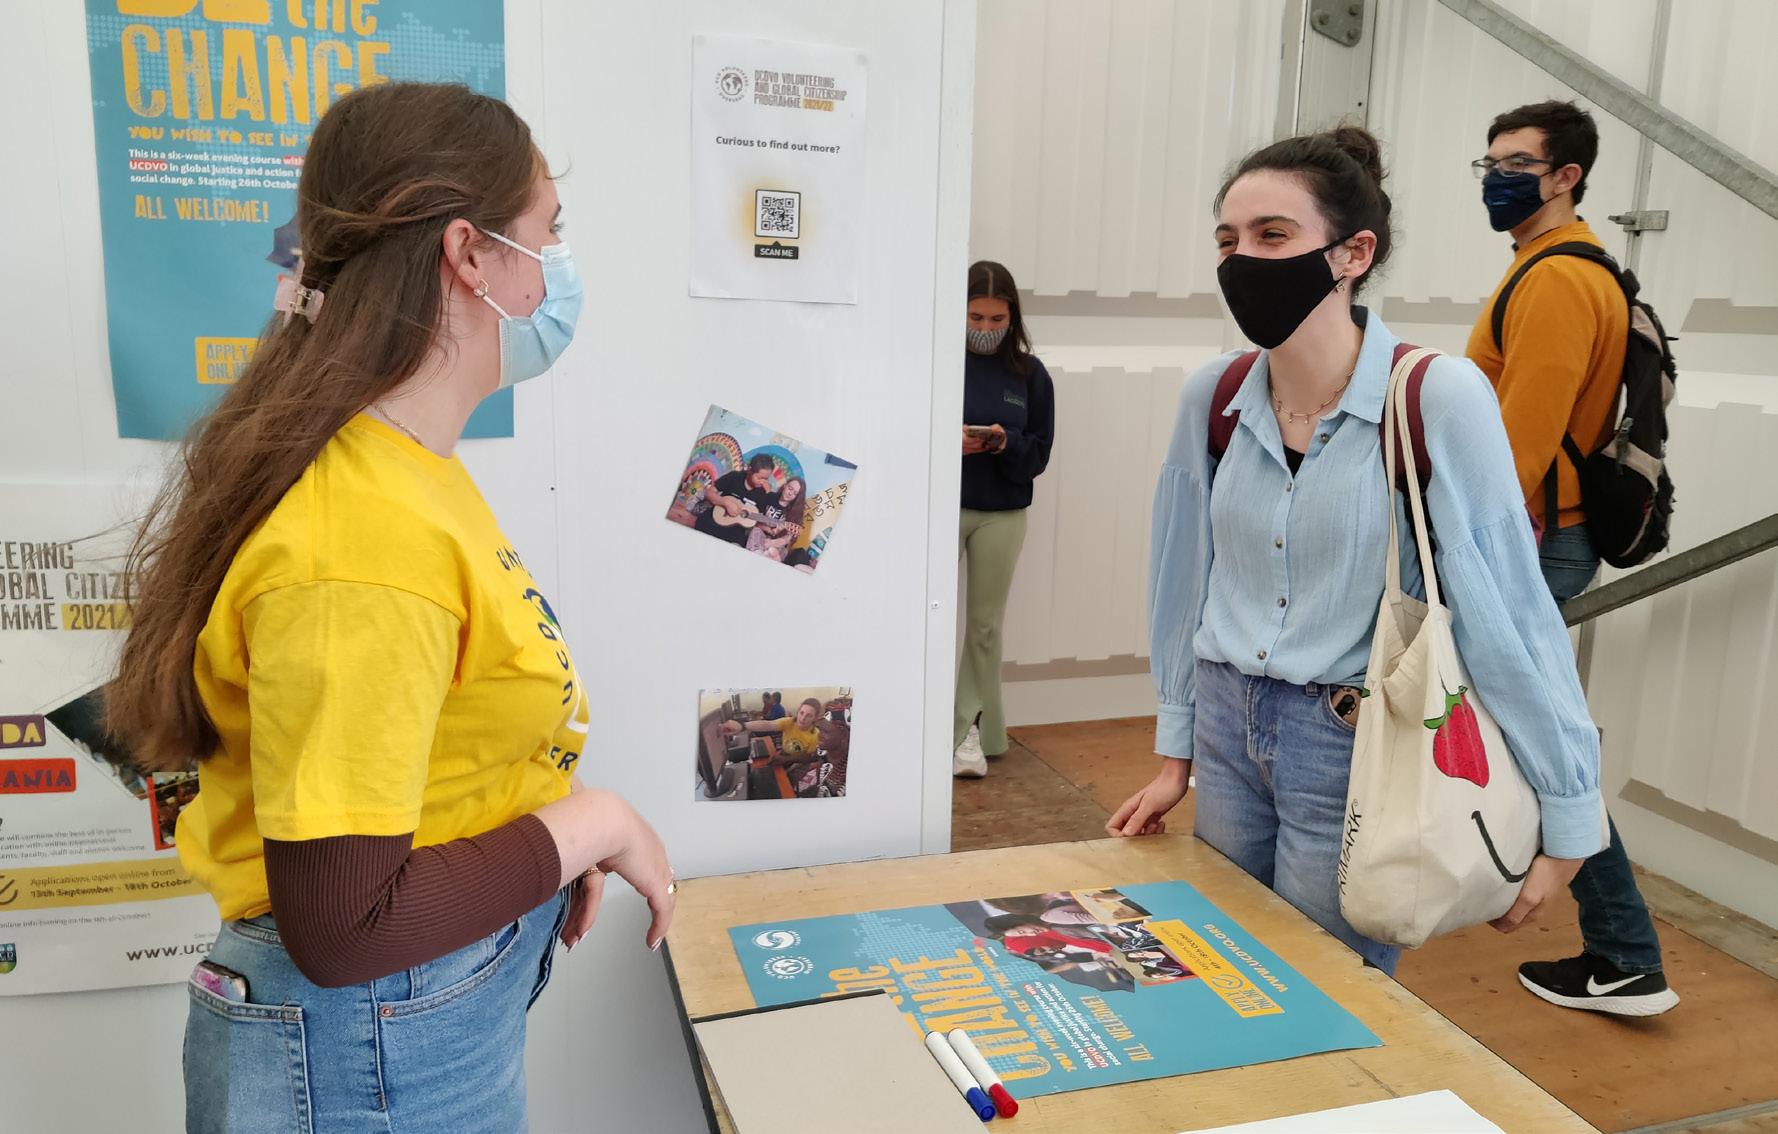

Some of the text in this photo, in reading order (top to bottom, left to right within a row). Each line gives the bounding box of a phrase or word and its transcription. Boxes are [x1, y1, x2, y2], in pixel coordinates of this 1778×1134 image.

[128, 126, 164, 140] YOU
[170, 128, 212, 143] WISH
[218, 130, 242, 144] TO
[248, 132, 274, 146] SEE
[280, 133, 298, 146] IN
[716, 136, 840, 154] Curious to find out more?
[128, 149, 148, 158] This
[150, 150, 158, 159] is
[168, 150, 210, 160] six-week
[212, 154, 248, 165] evening
[250, 156, 282, 164] course
[129, 160, 168, 171] UCDVO
[170, 163, 178, 172] in
[180, 164, 210, 174] global
[212, 164, 243, 176] justice
[246, 167, 262, 176] and
[264, 169, 294, 177] action
[130, 174, 158, 183] social
[160, 174, 196, 186] change.
[198, 176, 237, 189] Starting
[262, 179, 298, 189] Octobe
[136, 194, 269, 223] ALL WELCOME!
[760, 248, 780, 256] SCAN
[206, 344, 248, 361] APPLY
[31, 875, 91, 887] Applications
[152, 868, 176, 876] from
[56, 886, 113, 898] September
[151, 878, 192, 889] October
[1202, 923, 1288, 992] WWW.UCDVO.ORG
[1226, 991, 1259, 1012] APPLY
[1080, 995, 1154, 1062] ALL WELCOME!
[1053, 1053, 1077, 1072] YOU
[1083, 1057, 1097, 1069] This
[1087, 1047, 1109, 1067] UCDVO
[1102, 1050, 1122, 1065] social
